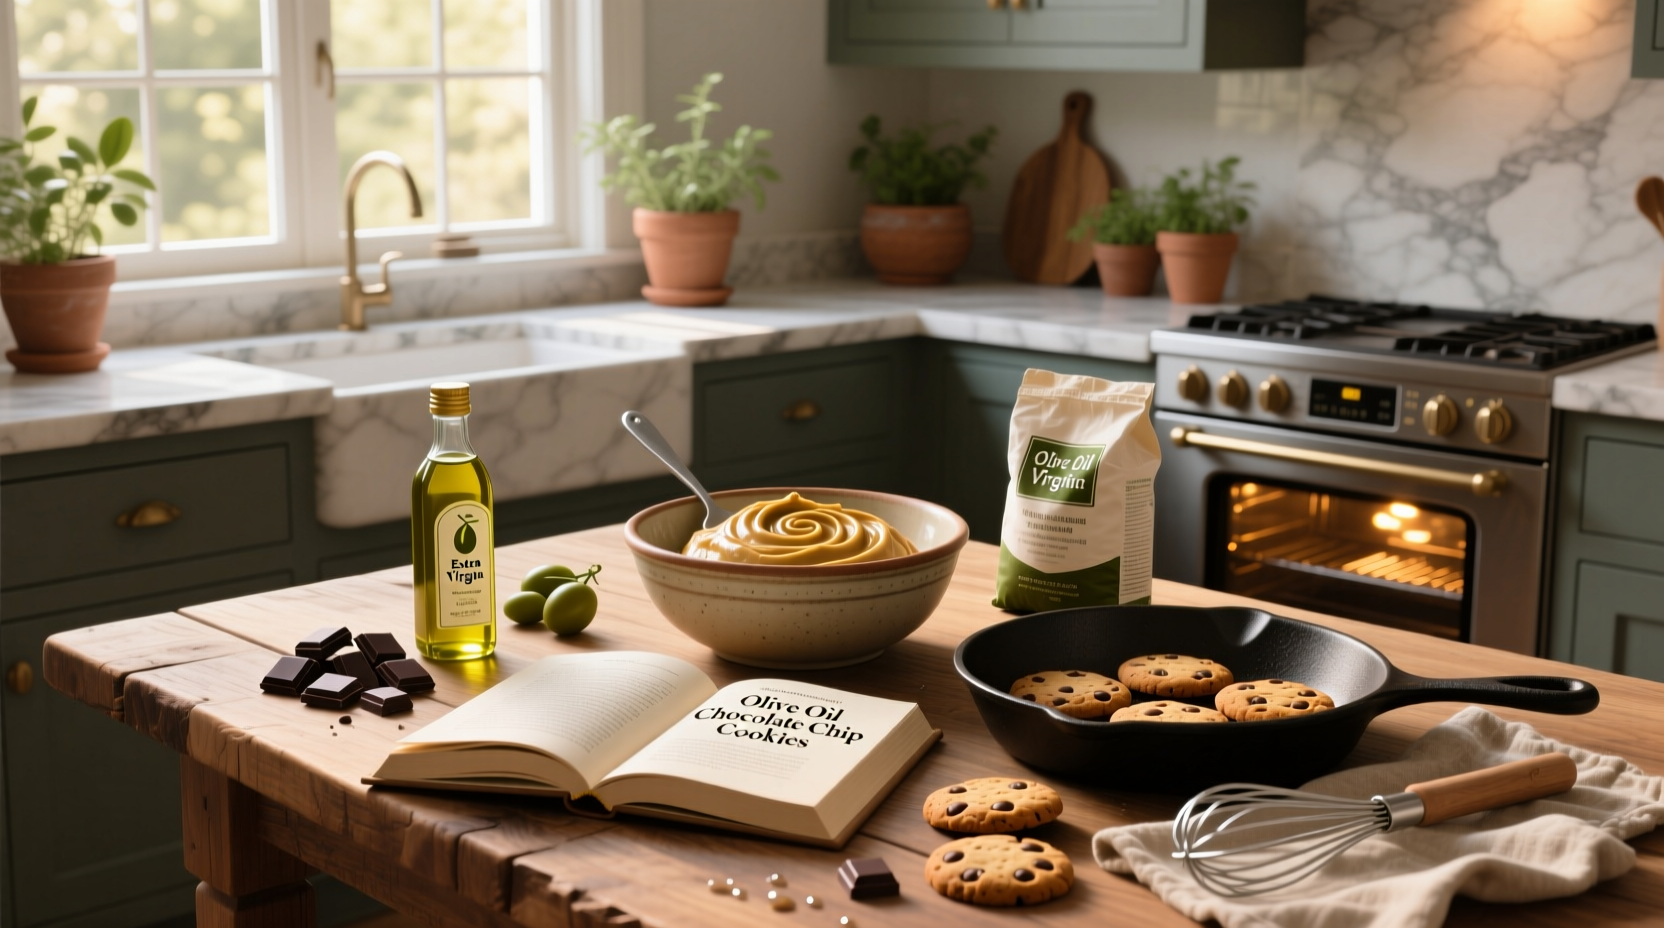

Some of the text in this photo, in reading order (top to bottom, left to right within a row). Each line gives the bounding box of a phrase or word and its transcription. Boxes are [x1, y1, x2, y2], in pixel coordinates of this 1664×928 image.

[1071, 453, 1096, 471] Oil
[740, 694, 800, 714] Olive
[804, 705, 845, 722] Oil
[694, 707, 864, 745] Chocolate Chip
[716, 723, 810, 748] Cookies
